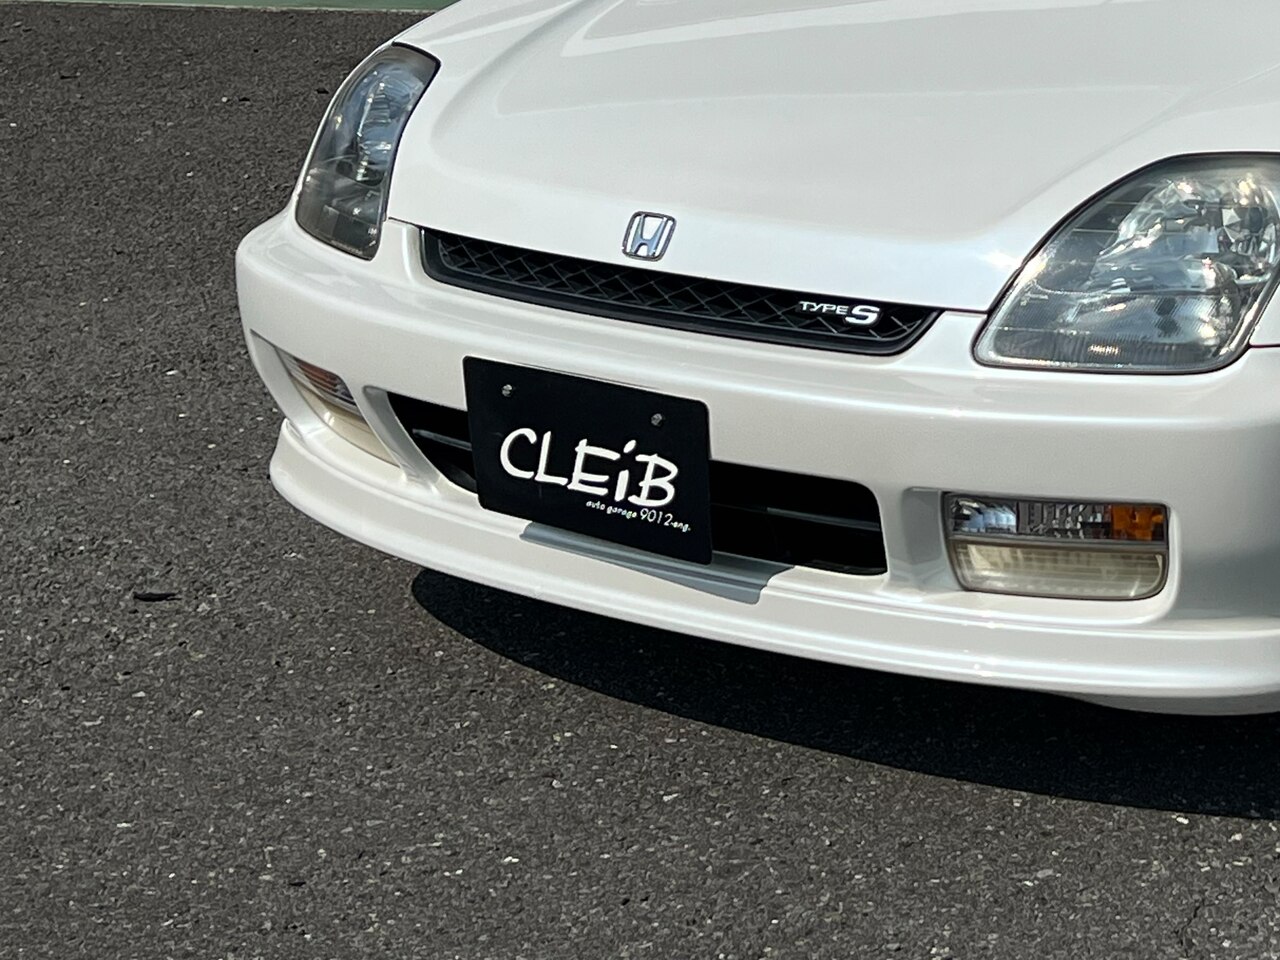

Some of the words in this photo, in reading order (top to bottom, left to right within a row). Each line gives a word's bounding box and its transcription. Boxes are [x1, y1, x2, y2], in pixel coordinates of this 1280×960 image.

[799, 300, 849, 315] TYPE
[845, 305, 880, 325] S
[586, 500, 606, 510] auto
[606, 506, 638, 520] garage
